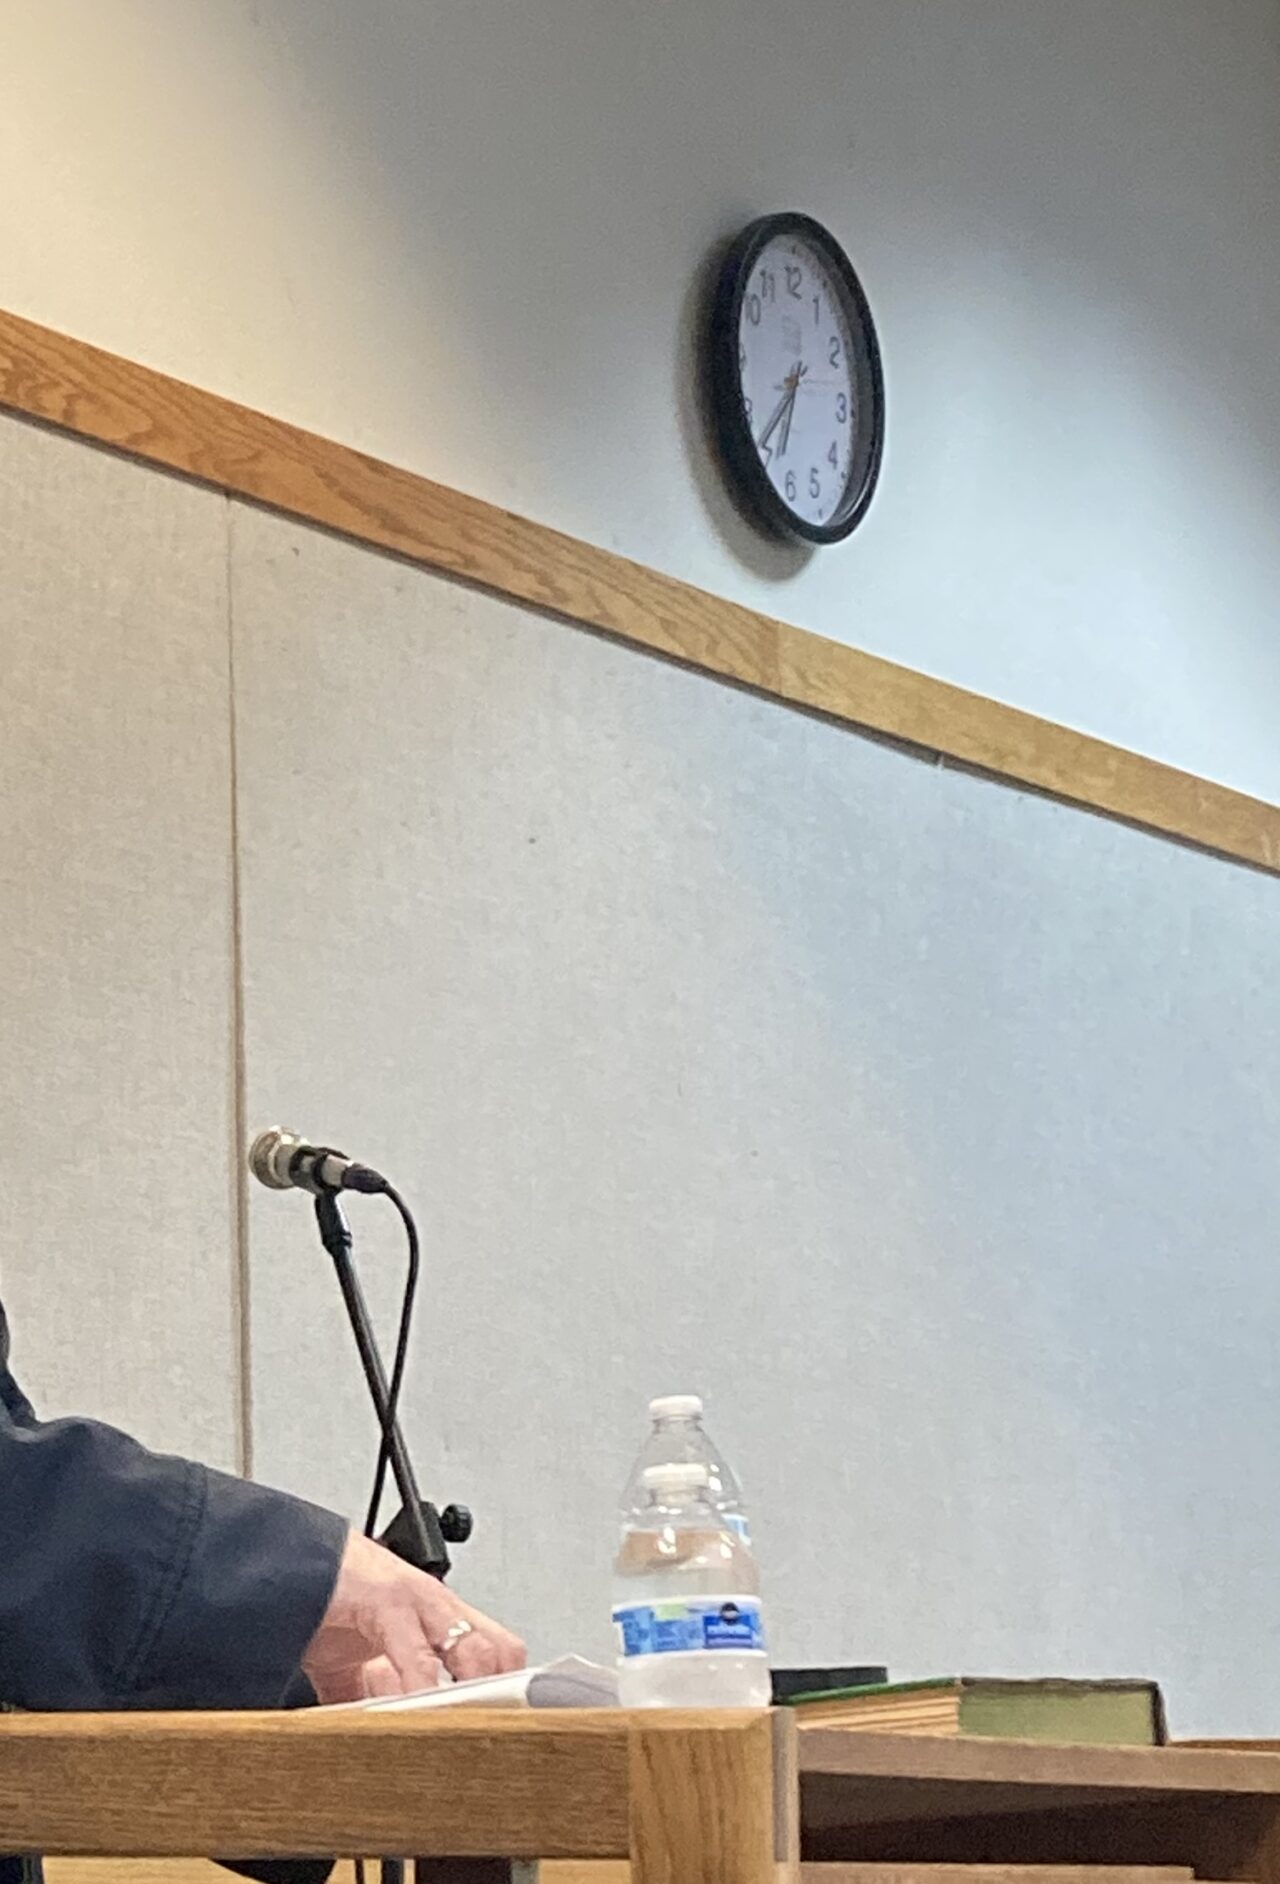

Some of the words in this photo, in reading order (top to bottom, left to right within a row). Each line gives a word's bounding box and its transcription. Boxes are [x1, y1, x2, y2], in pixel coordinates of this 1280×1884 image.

[759, 269, 776, 303] 11
[784, 265, 802, 300] 12
[812, 295, 820, 325] 1
[829, 336, 841, 369] 2
[836, 392, 847, 424] 3
[827, 440, 839, 470] 4
[785, 469, 797, 502] 6
[809, 466, 821, 499] 5
